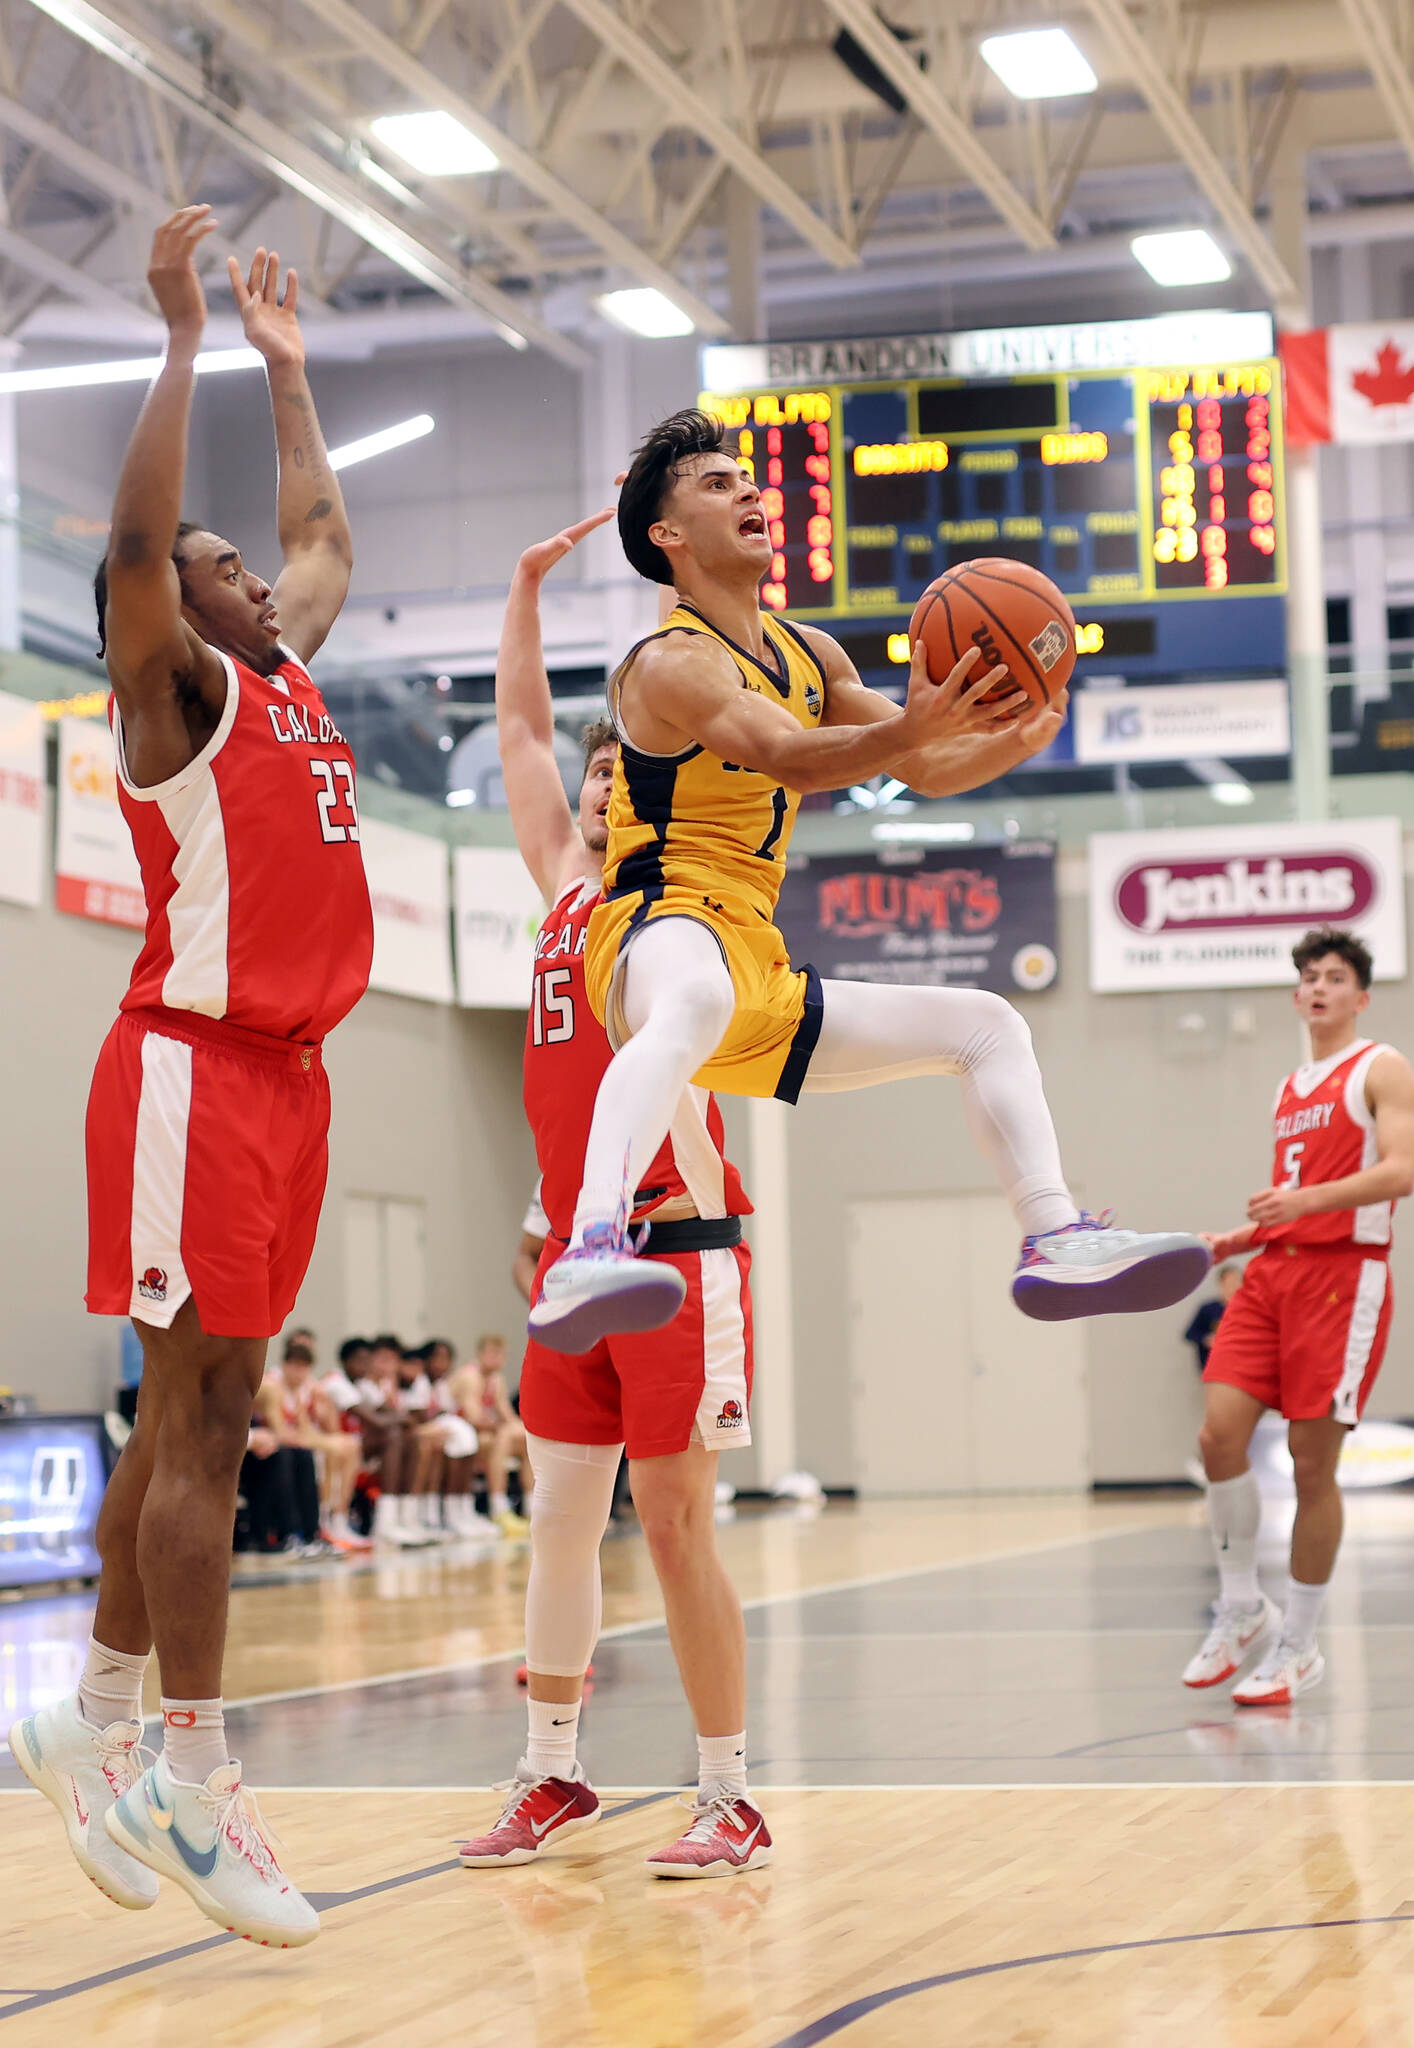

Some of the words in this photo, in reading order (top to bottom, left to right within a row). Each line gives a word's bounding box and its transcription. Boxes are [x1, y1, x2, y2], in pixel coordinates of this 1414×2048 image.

[767, 341, 949, 379] BRANDON
[970, 328, 1142, 372] UNIVERS
[308, 757, 361, 844] 23
[754, 786, 790, 862] 1
[818, 869, 1003, 935] MUM'S
[1139, 857, 1356, 933] Jenkins
[1174, 944, 1282, 963] FLOORING
[533, 966, 576, 1047] 15
[1280, 1141, 1305, 1191] 5
